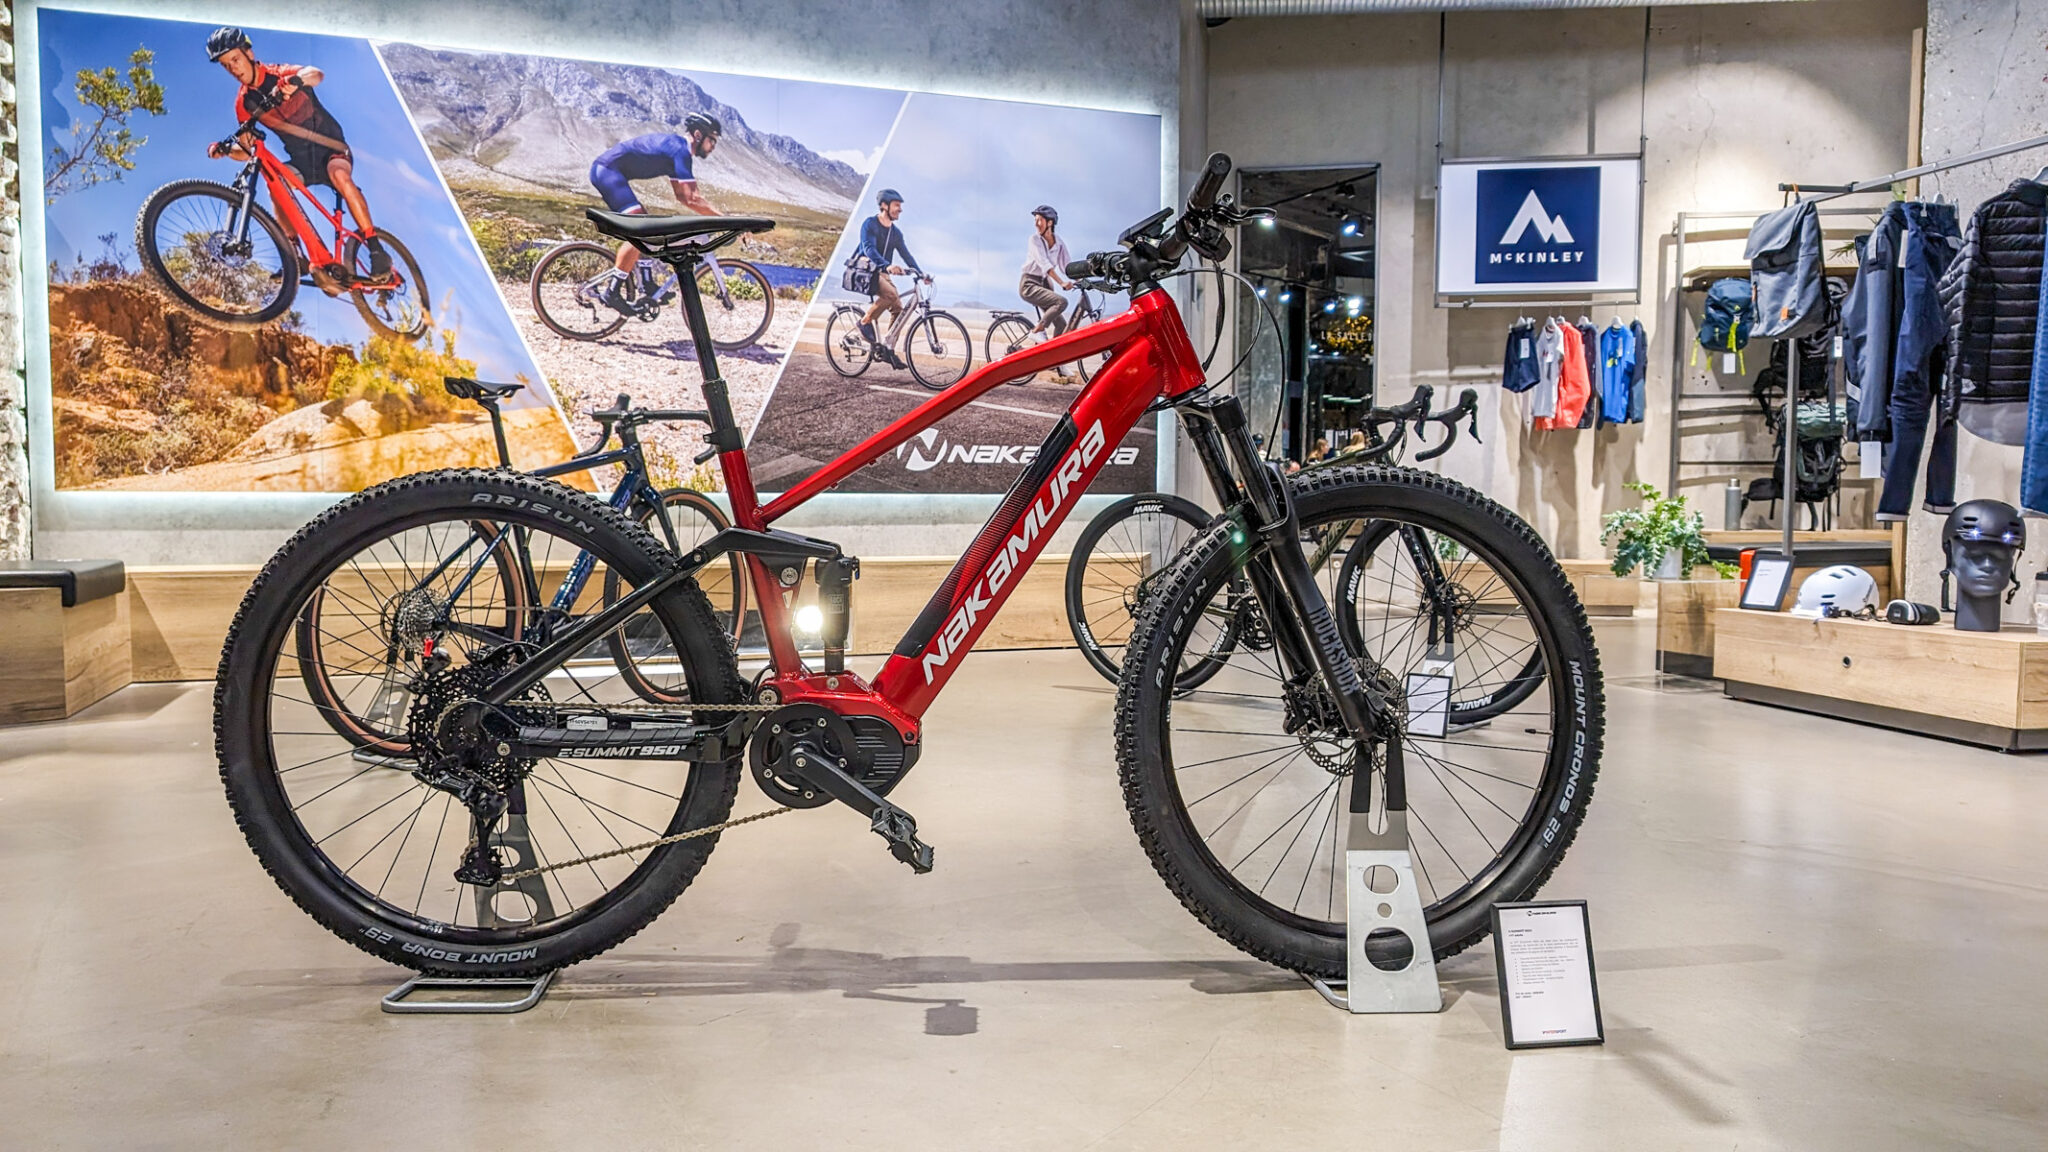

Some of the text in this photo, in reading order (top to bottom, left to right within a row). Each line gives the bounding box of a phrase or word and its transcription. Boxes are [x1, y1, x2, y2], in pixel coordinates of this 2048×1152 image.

[471, 492, 597, 534] ARISUN
[1132, 504, 1164, 515] MAVIC
[1346, 565, 1362, 605] MAVIC
[1078, 621, 1100, 651] MAVIC
[1155, 578, 1209, 689] ARISUN
[1309, 607, 1362, 697] ROCKSHOX
[1455, 694, 1493, 711] MAVIC
[1569, 660, 1587, 727] MOUNT
[1558, 731, 1587, 814] CRONOS
[401, 942, 460, 963] BONA
[465, 947, 538, 964] MOUNT
